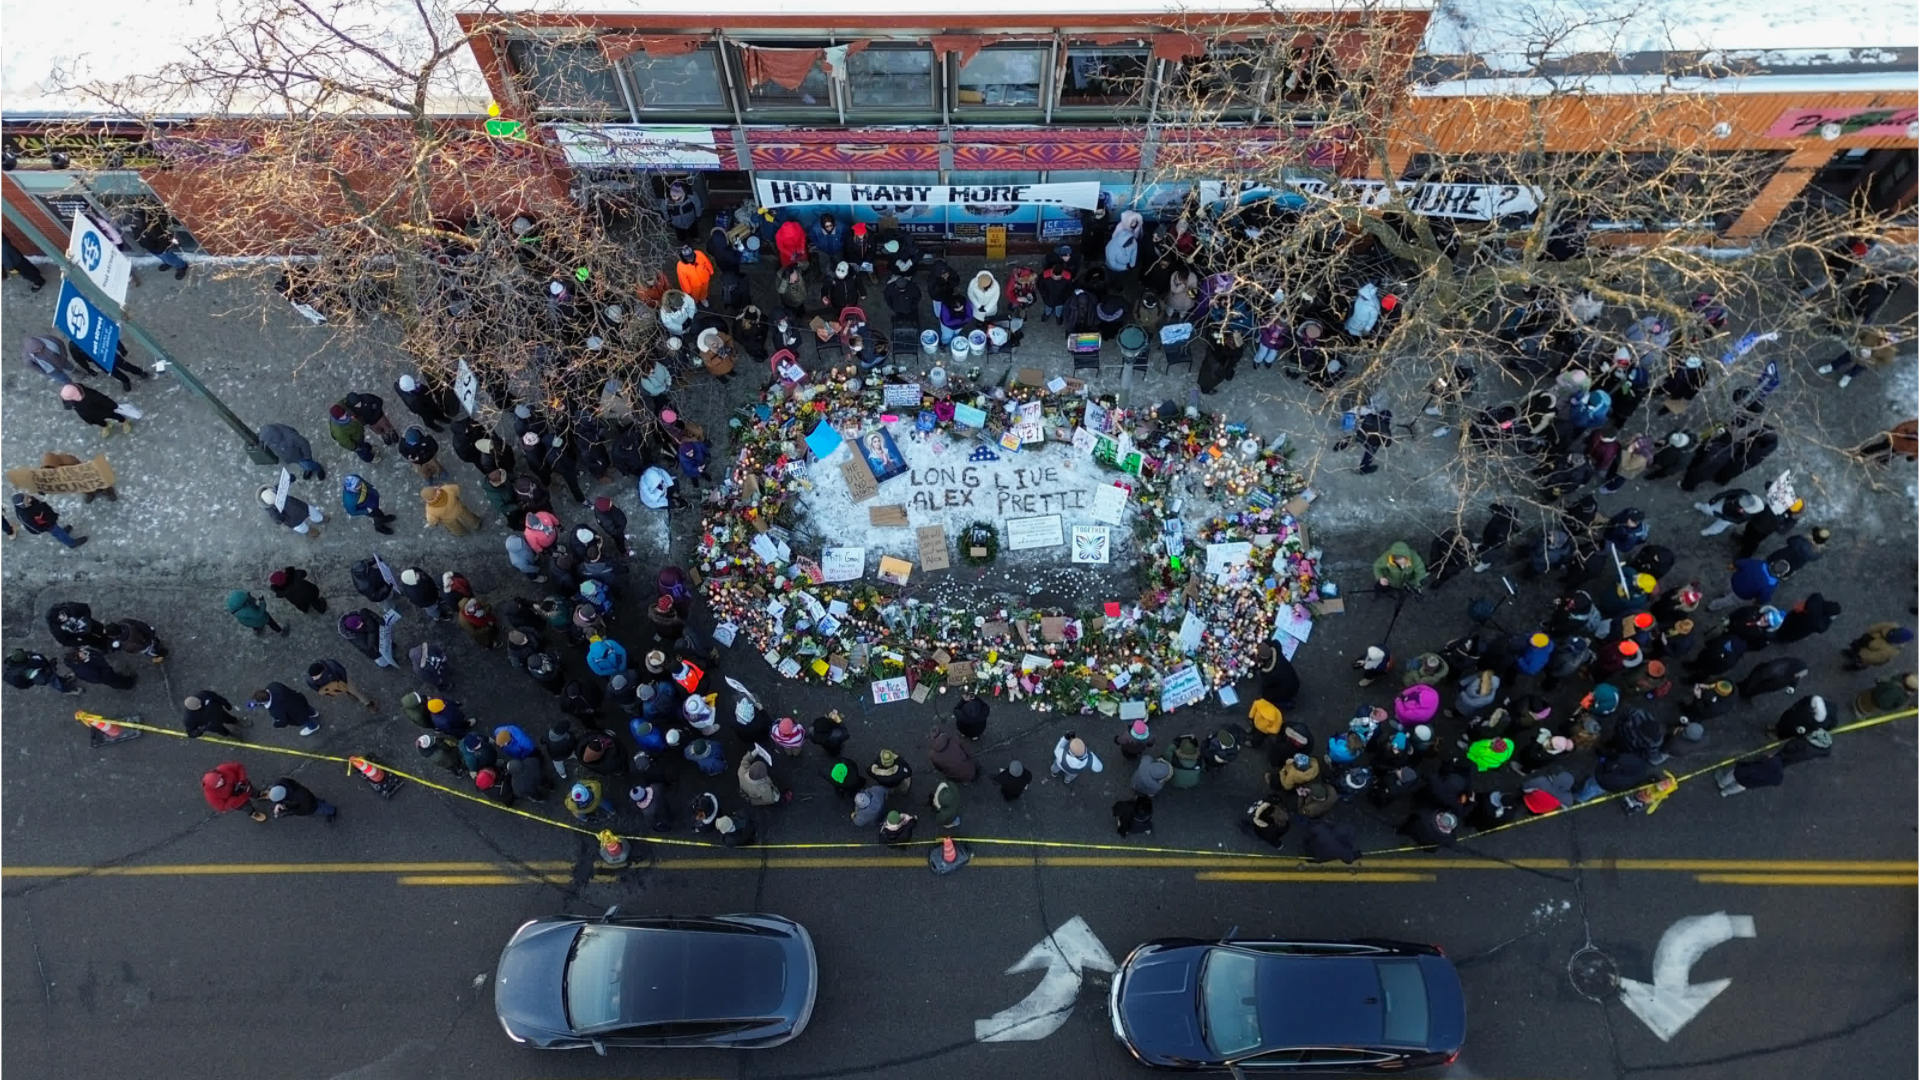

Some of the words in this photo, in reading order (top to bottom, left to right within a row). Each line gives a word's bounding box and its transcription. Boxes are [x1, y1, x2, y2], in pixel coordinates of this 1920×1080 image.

[771, 181, 832, 202] HOW
[851, 185, 931, 202] MANY
[950, 185, 1063, 203] MORE...
[94, 316, 103, 340] street
[1021, 404, 1039, 416] TOP
[846, 463, 858, 473] HE
[845, 471, 864, 484] DID
[911, 466, 980, 488] LONG
[994, 467, 1059, 490] LIVE
[854, 479, 867, 489] NO
[914, 489, 975, 511] ALEX
[997, 488, 1087, 515] PRETTI
[1076, 526, 1107, 534] TOGETHER
[844, 552, 860, 563] Good
[926, 556, 943, 565] Alex
[953, 662, 968, 672] ICE
[874, 680, 900, 694] Justice
